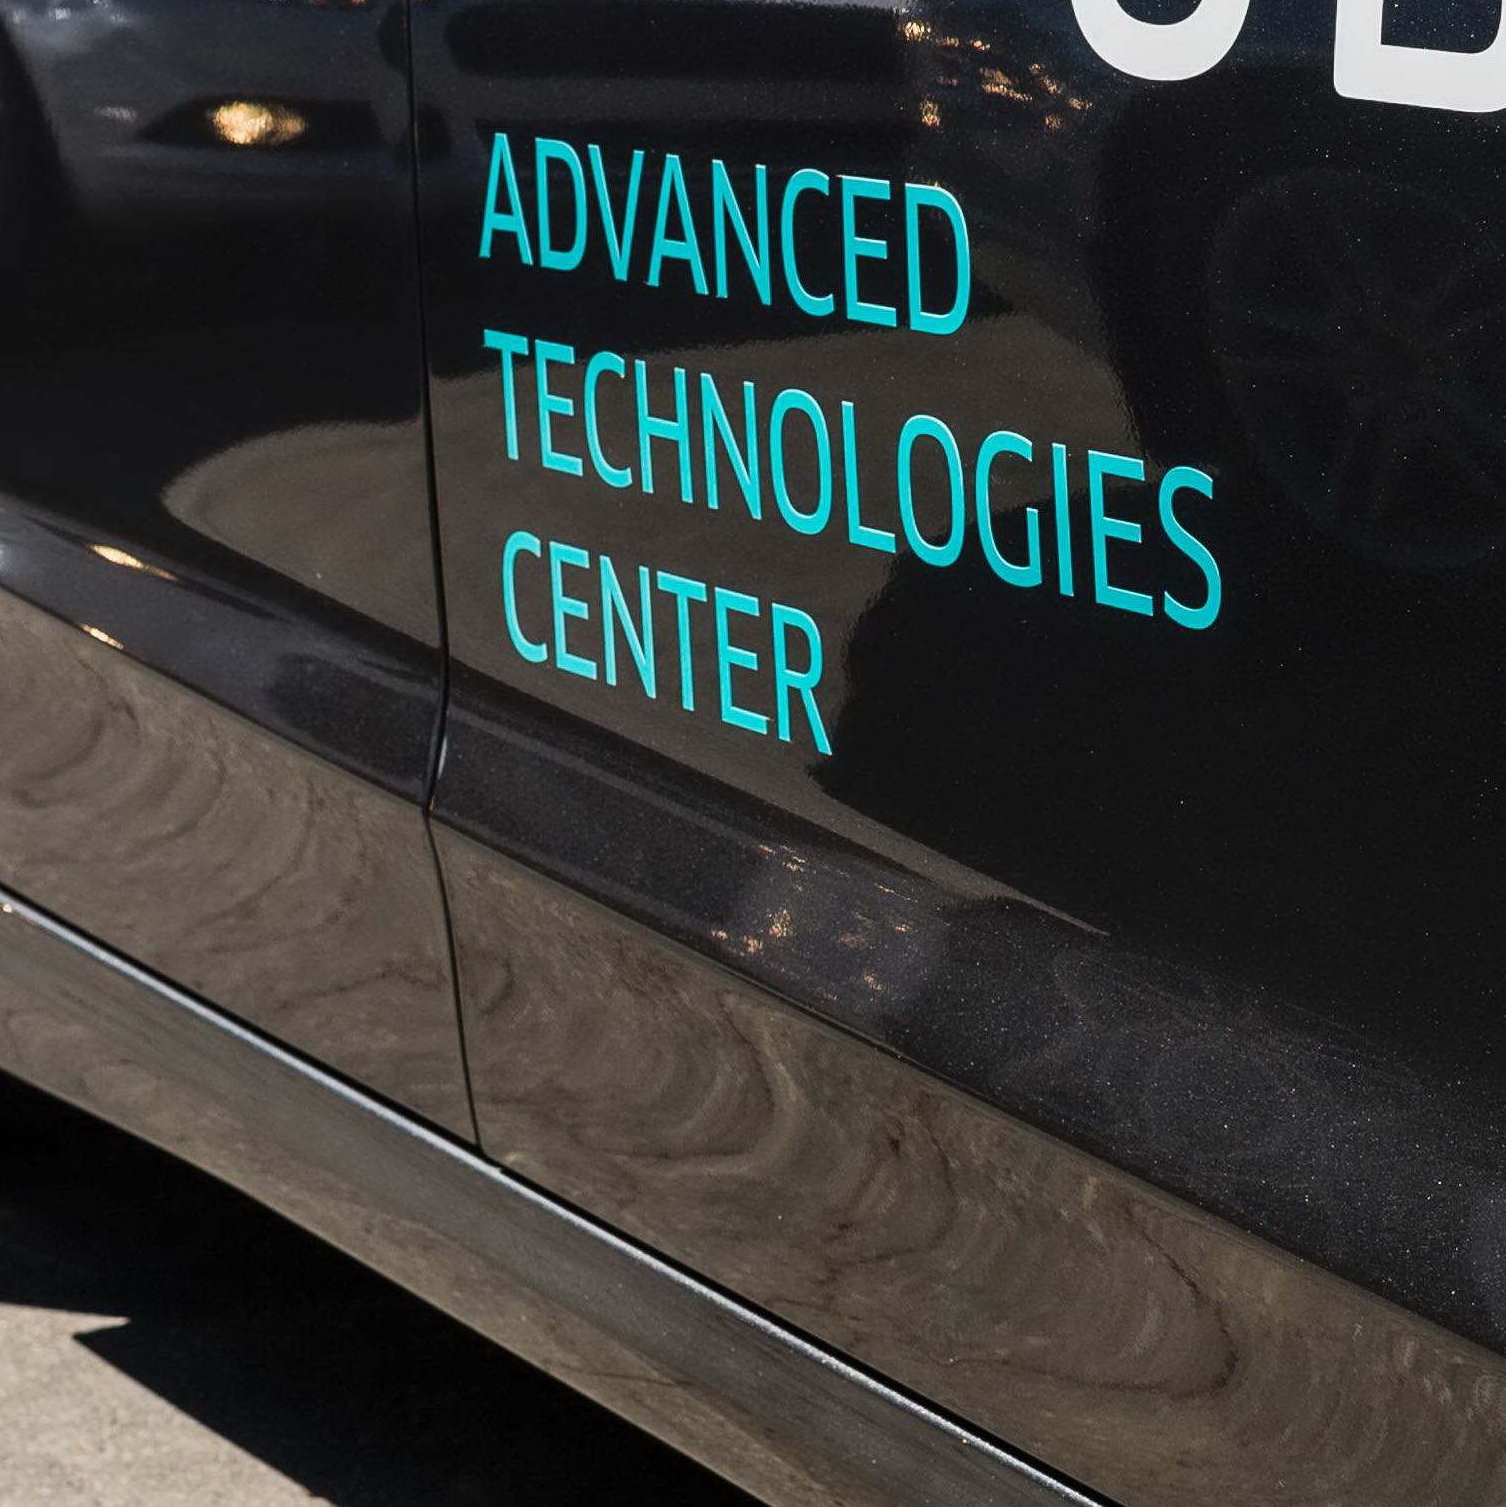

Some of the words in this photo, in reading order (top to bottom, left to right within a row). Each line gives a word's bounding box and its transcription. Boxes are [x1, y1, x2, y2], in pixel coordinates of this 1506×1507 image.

[479, 132, 972, 336] ADVANCED
[483, 328, 1223, 631] TECHNOLOGIES
[502, 530, 833, 756] CENTER
